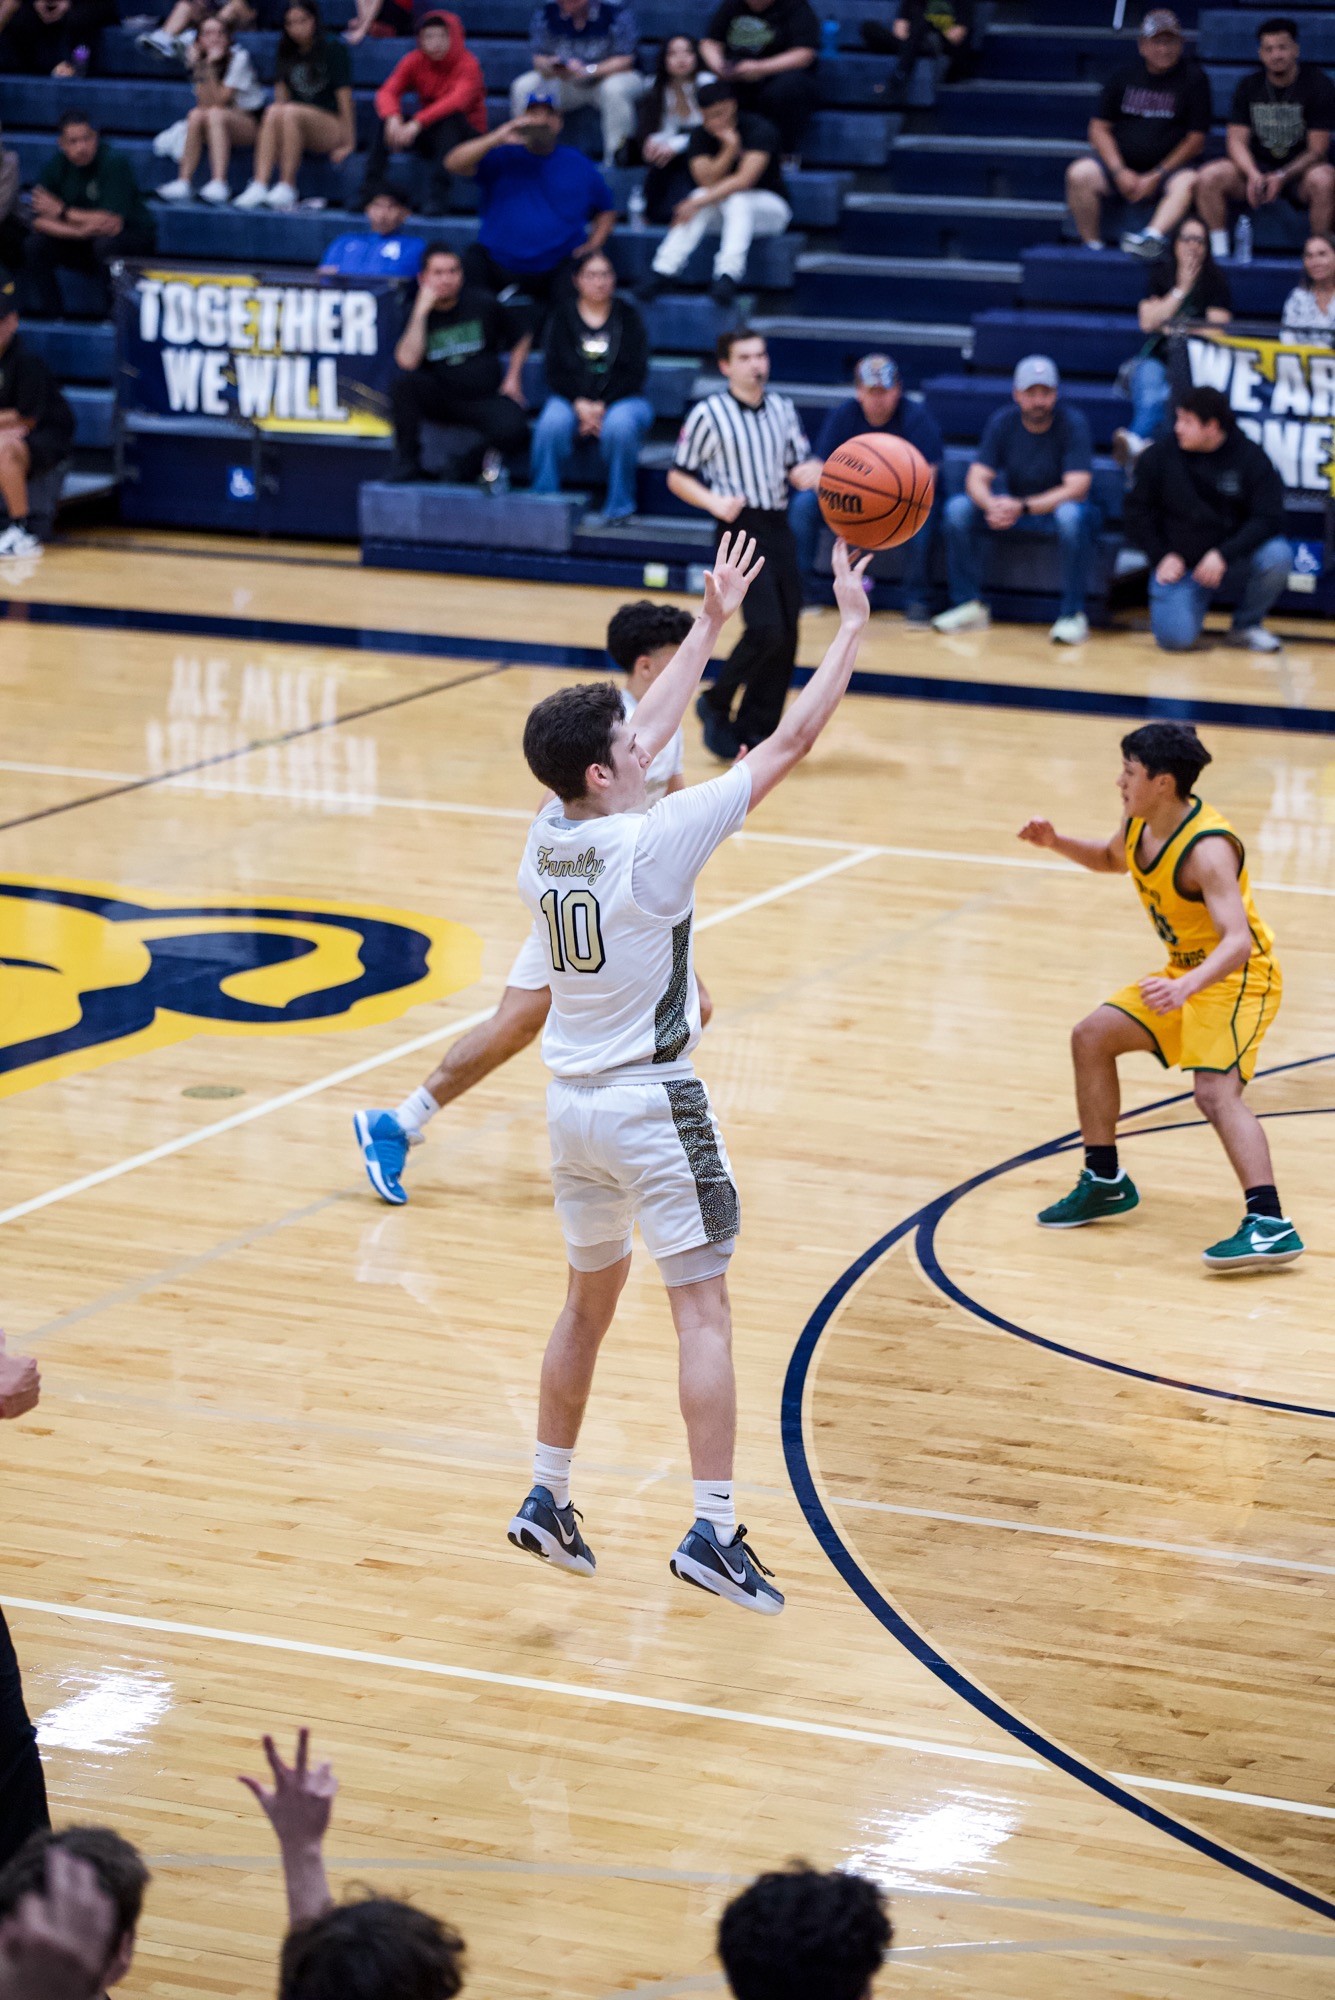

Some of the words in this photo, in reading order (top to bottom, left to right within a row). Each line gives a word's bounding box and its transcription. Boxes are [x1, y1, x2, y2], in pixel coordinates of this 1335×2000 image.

[134, 278, 378, 355] TOGETHER
[160, 347, 230, 415] WE
[234, 354, 350, 421] WILL
[1187, 338, 1262, 413] WE
[537, 845, 606, 886] Family
[540, 889, 606, 974] 10
